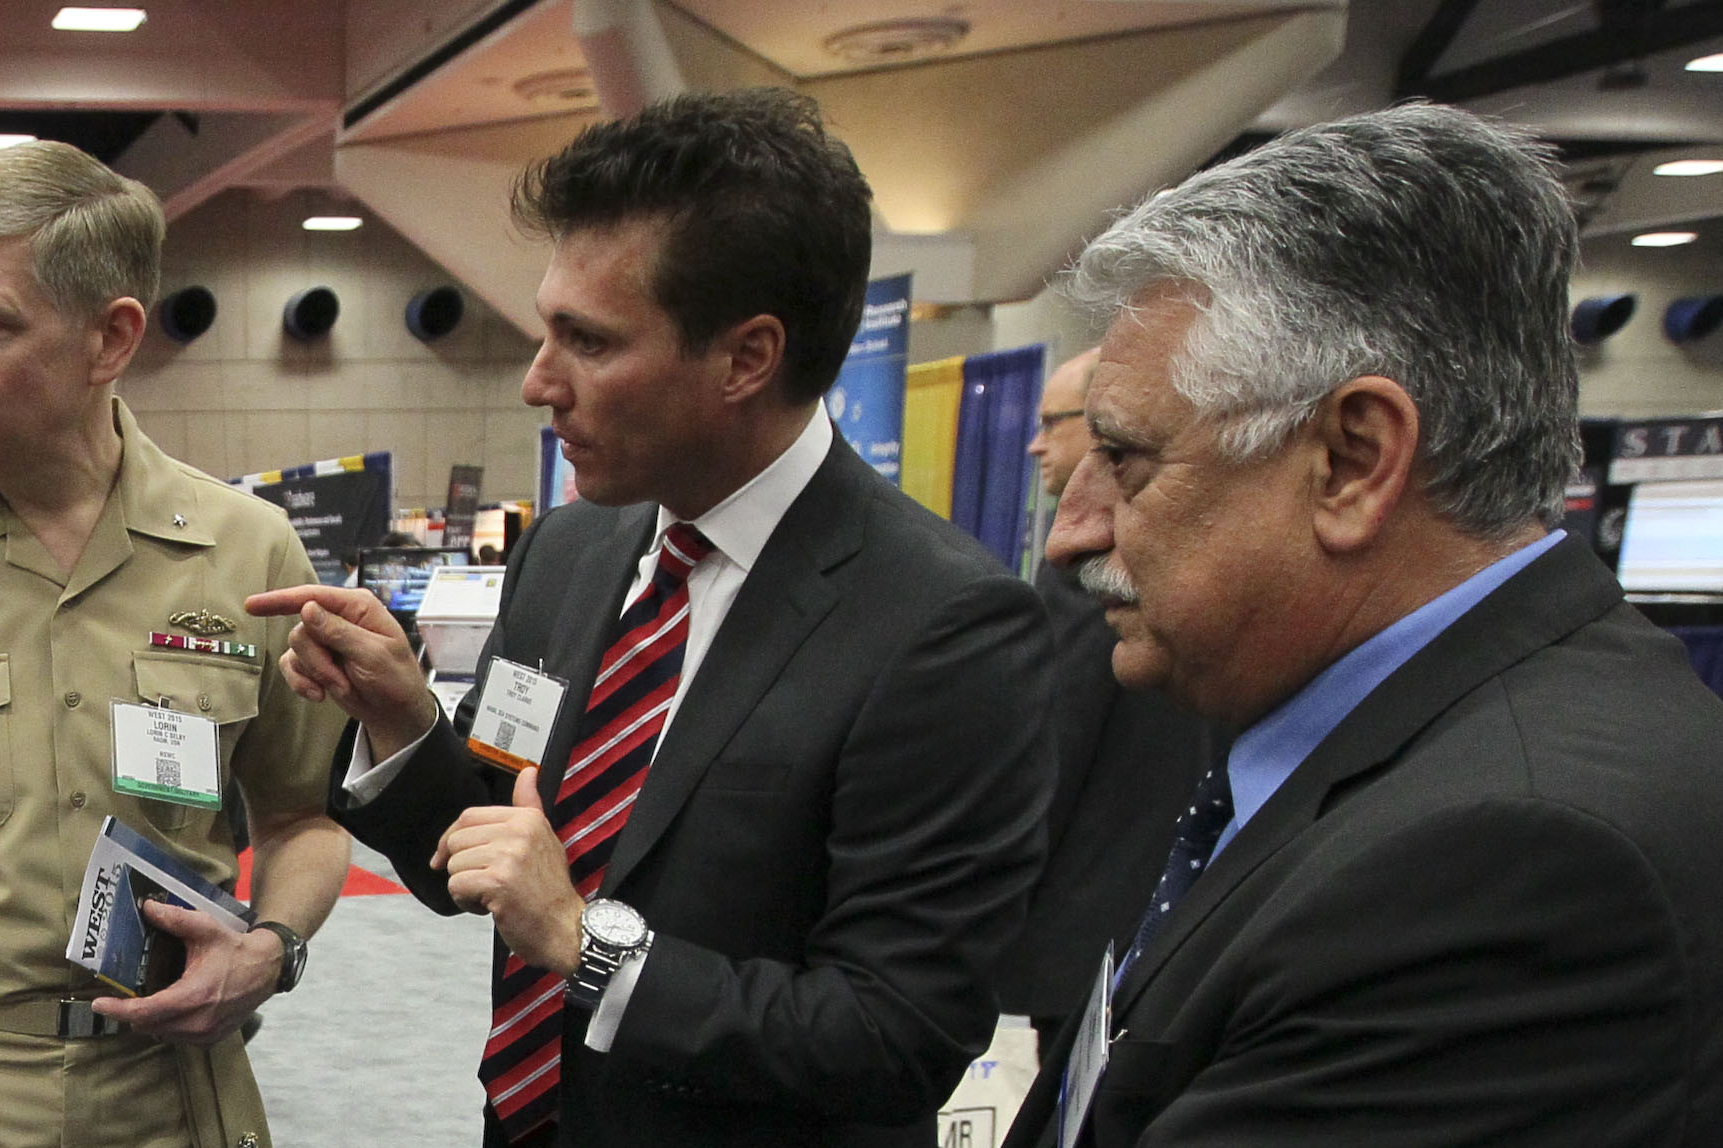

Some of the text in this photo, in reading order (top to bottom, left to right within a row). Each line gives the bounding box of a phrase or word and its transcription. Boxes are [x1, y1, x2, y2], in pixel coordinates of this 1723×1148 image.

[513, 681, 530, 696] TROY
[148, 711, 182, 723] WEST 2015
[153, 721, 178, 732] LORIN
[103, 861, 122, 923] 2015
[82, 868, 110, 960] WEST
